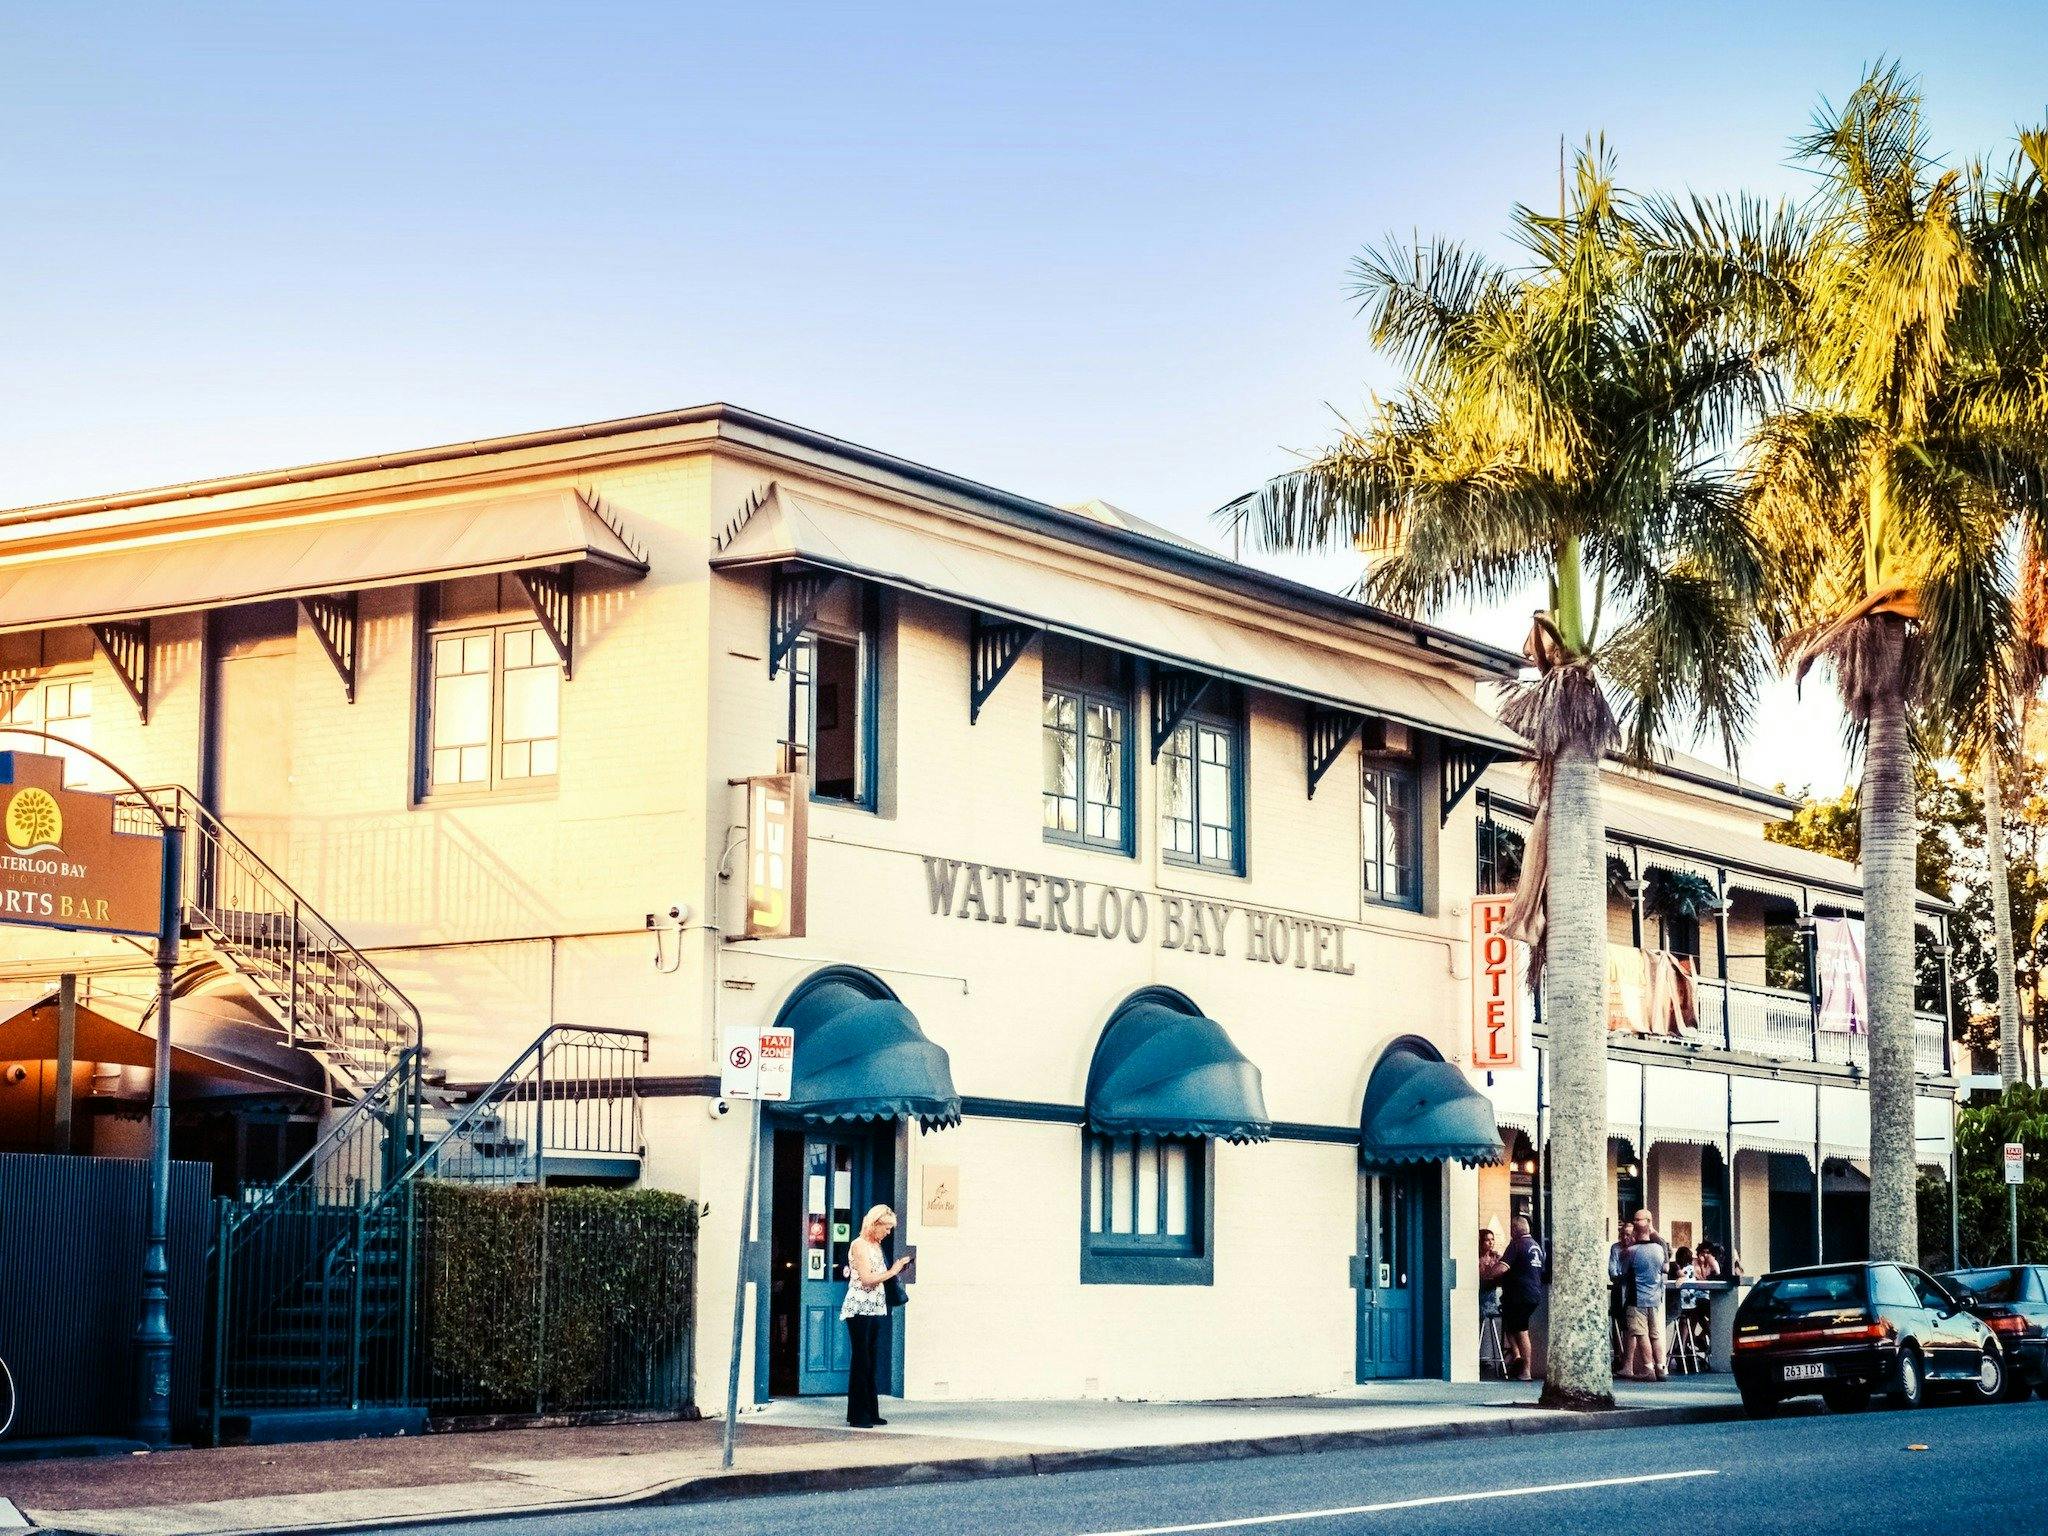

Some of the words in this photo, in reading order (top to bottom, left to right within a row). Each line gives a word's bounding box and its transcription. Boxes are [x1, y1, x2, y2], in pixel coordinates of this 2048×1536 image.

[0, 856, 57, 875] TERLOO
[61, 863, 87, 878] BAY
[0, 889, 53, 916] RTS
[60, 895, 112, 921] BAR
[921, 855, 1149, 943] WATERLOO
[1160, 894, 1234, 956] BAY
[1244, 908, 1355, 976] HOTEL
[1484, 906, 1507, 1060] HOTEL
[761, 1047, 791, 1058] ZONE
[765, 1036, 790, 1047] TAXI
